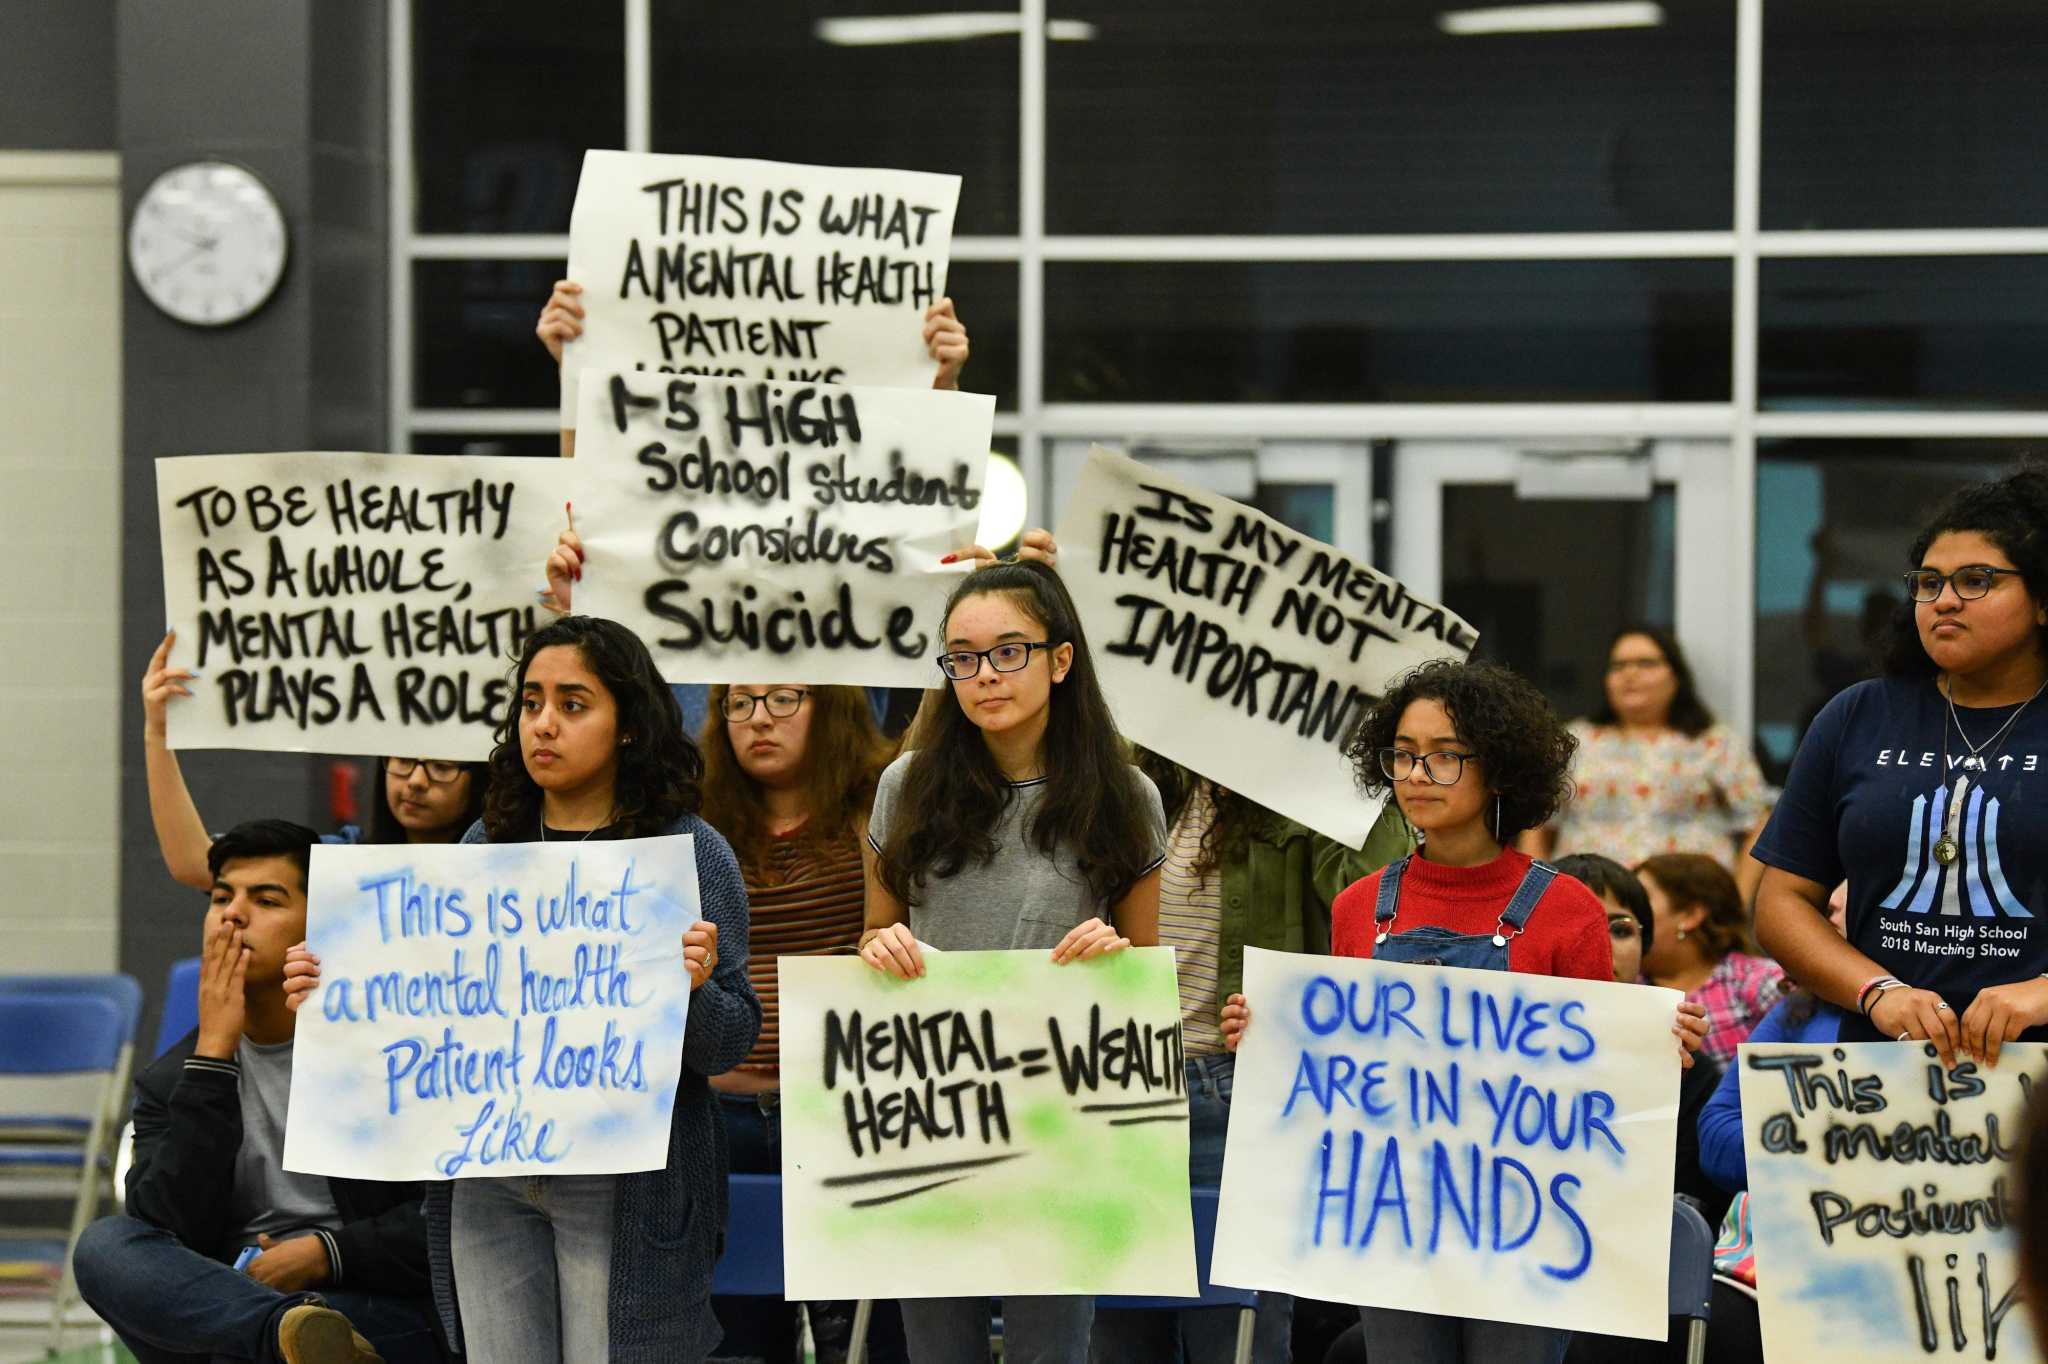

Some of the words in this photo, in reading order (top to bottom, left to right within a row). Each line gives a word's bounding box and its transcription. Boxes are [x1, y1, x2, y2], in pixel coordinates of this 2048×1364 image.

[642, 178, 748, 236] THIS
[760, 189, 804, 238] IS
[819, 194, 941, 249] WHAT
[619, 239, 651, 299] A
[655, 242, 805, 302] MENTAL
[817, 250, 935, 310] HEALTH
[650, 311, 830, 361] PATIENT
[176, 486, 237, 538] TO
[245, 484, 316, 532] BE
[325, 478, 515, 540] HEALTHY
[660, 508, 894, 573] Considers
[198, 547, 254, 601] AS
[266, 535, 298, 600] A
[306, 543, 471, 602] WHOLE,
[1099, 512, 1266, 615] HEALTH
[1271, 588, 1400, 662] NOT
[1134, 483, 1213, 534] IS
[1221, 513, 1301, 567] MY
[1299, 550, 1473, 652] MENTAL
[198, 606, 372, 669] MENTAL
[381, 602, 535, 659] HEALTH
[644, 579, 928, 660] Suicide
[217, 665, 341, 729] PLAYS
[347, 662, 386, 723] A
[396, 667, 508, 728] ROLE
[1106, 593, 1384, 754] IMPORTANT
[359, 867, 473, 943] This
[487, 886, 524, 937] is
[535, 857, 655, 934] what
[1880, 917, 1911, 934] South
[1915, 922, 1940, 937] San
[1944, 925, 1974, 941] High
[1979, 925, 2028, 940] School
[323, 974, 357, 1023] a
[364, 942, 509, 1023] mental
[519, 942, 648, 1019] health
[1881, 936, 1910, 951] 2018
[1914, 940, 1975, 959] Marching
[1980, 943, 2020, 957] Show
[823, 1008, 1017, 1090] MENTAL
[1048, 1003, 1188, 1096] WEALTH
[1301, 975, 1425, 1040] OUR
[1439, 985, 1597, 1063] LIVES
[381, 1019, 524, 1115] Patient
[533, 1015, 647, 1091] looks
[1281, 1049, 1396, 1118] ARE
[1408, 1062, 1460, 1127] IN
[1482, 1073, 1626, 1156] YOUR
[1748, 1048, 1887, 1118] This
[1924, 1043, 1986, 1105] is
[437, 1099, 562, 1177] Like
[844, 1079, 1011, 1157] HEALTH
[1761, 1112, 1807, 1154] a
[1823, 1107, 2010, 1165] mental
[1313, 1128, 1593, 1282] HANDS
